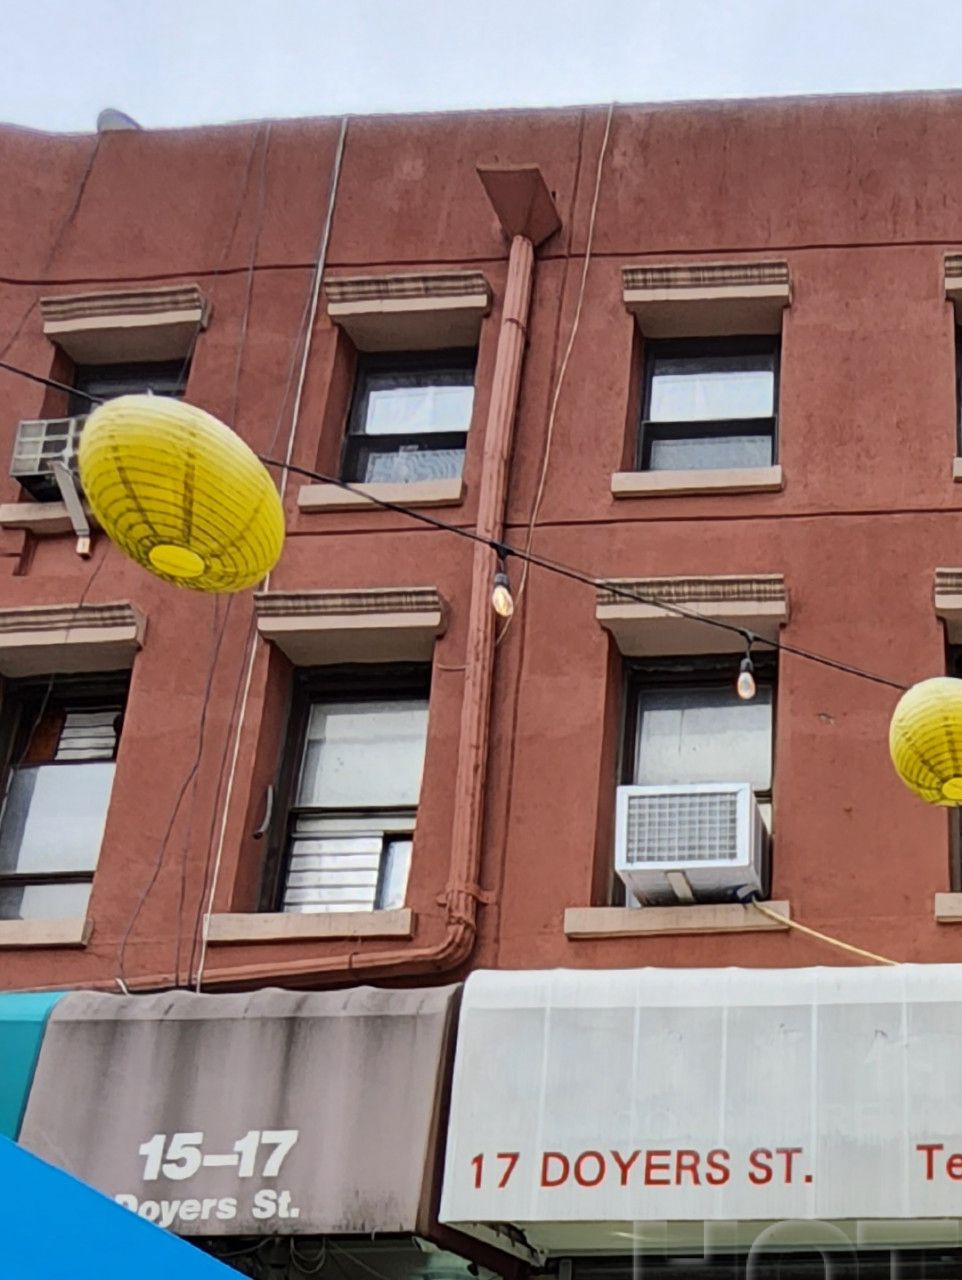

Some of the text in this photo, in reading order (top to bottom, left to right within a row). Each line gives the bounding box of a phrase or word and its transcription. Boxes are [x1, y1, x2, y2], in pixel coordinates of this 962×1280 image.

[138, 1129, 299, 1181] 15-17
[470, 1146, 814, 1189] 17 DOYERS ST.
[252, 1189, 300, 1220] St.
